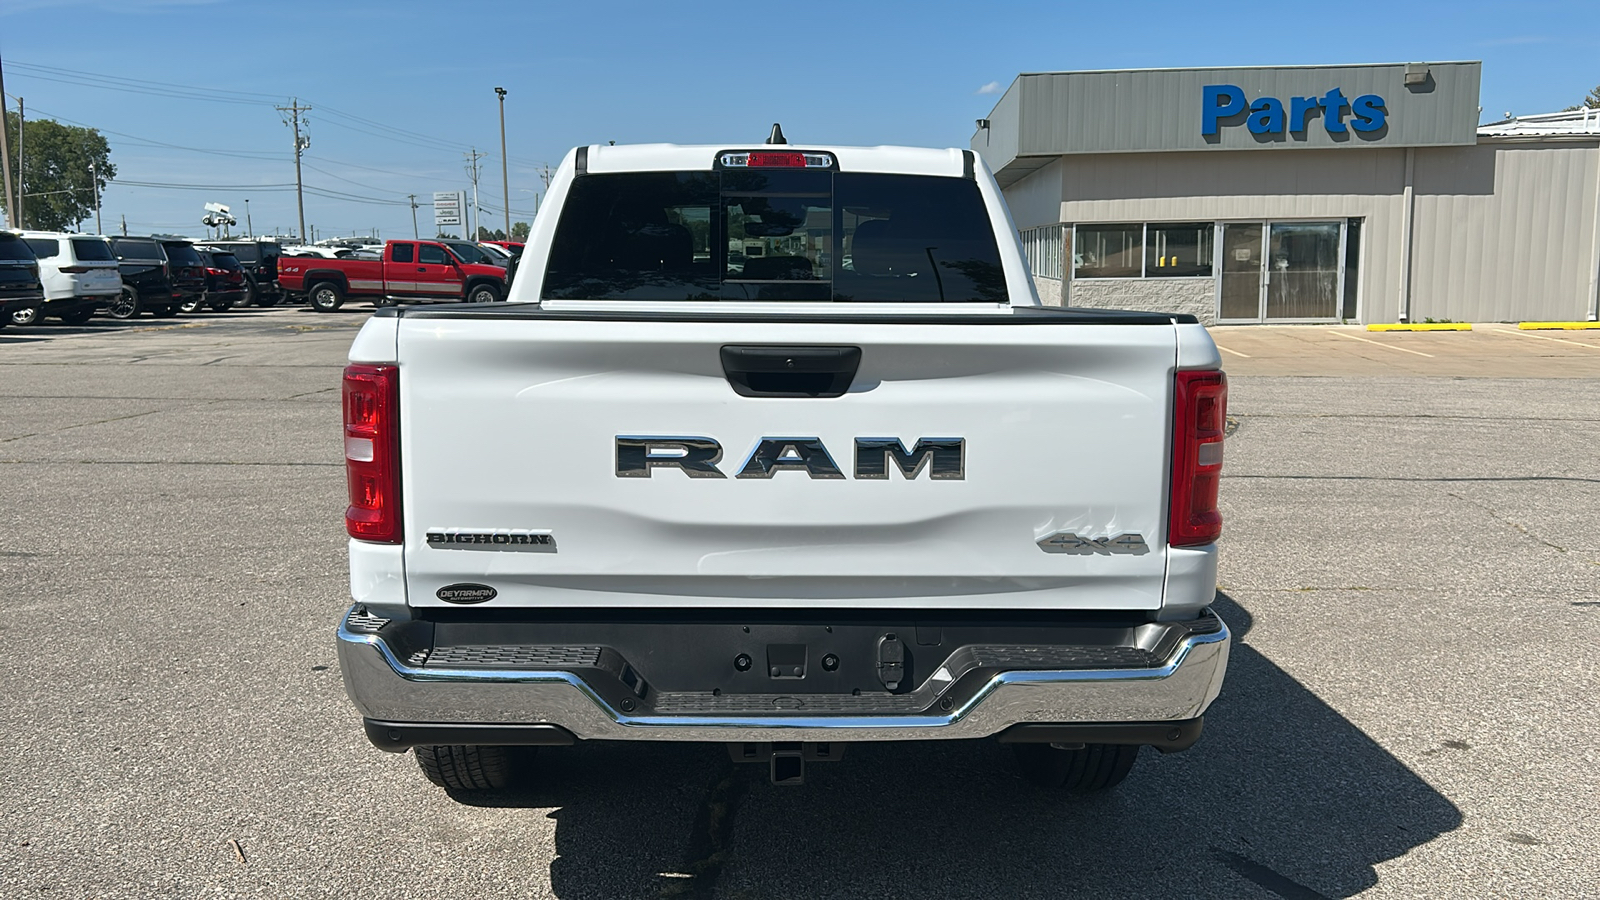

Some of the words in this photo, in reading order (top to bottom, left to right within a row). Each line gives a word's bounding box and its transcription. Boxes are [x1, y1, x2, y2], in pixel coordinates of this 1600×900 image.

[1202, 84, 1387, 135] Parts
[615, 434, 966, 480] RAM
[426, 532, 550, 545] BIGHORN
[440, 589, 493, 597] DEYARMAN
